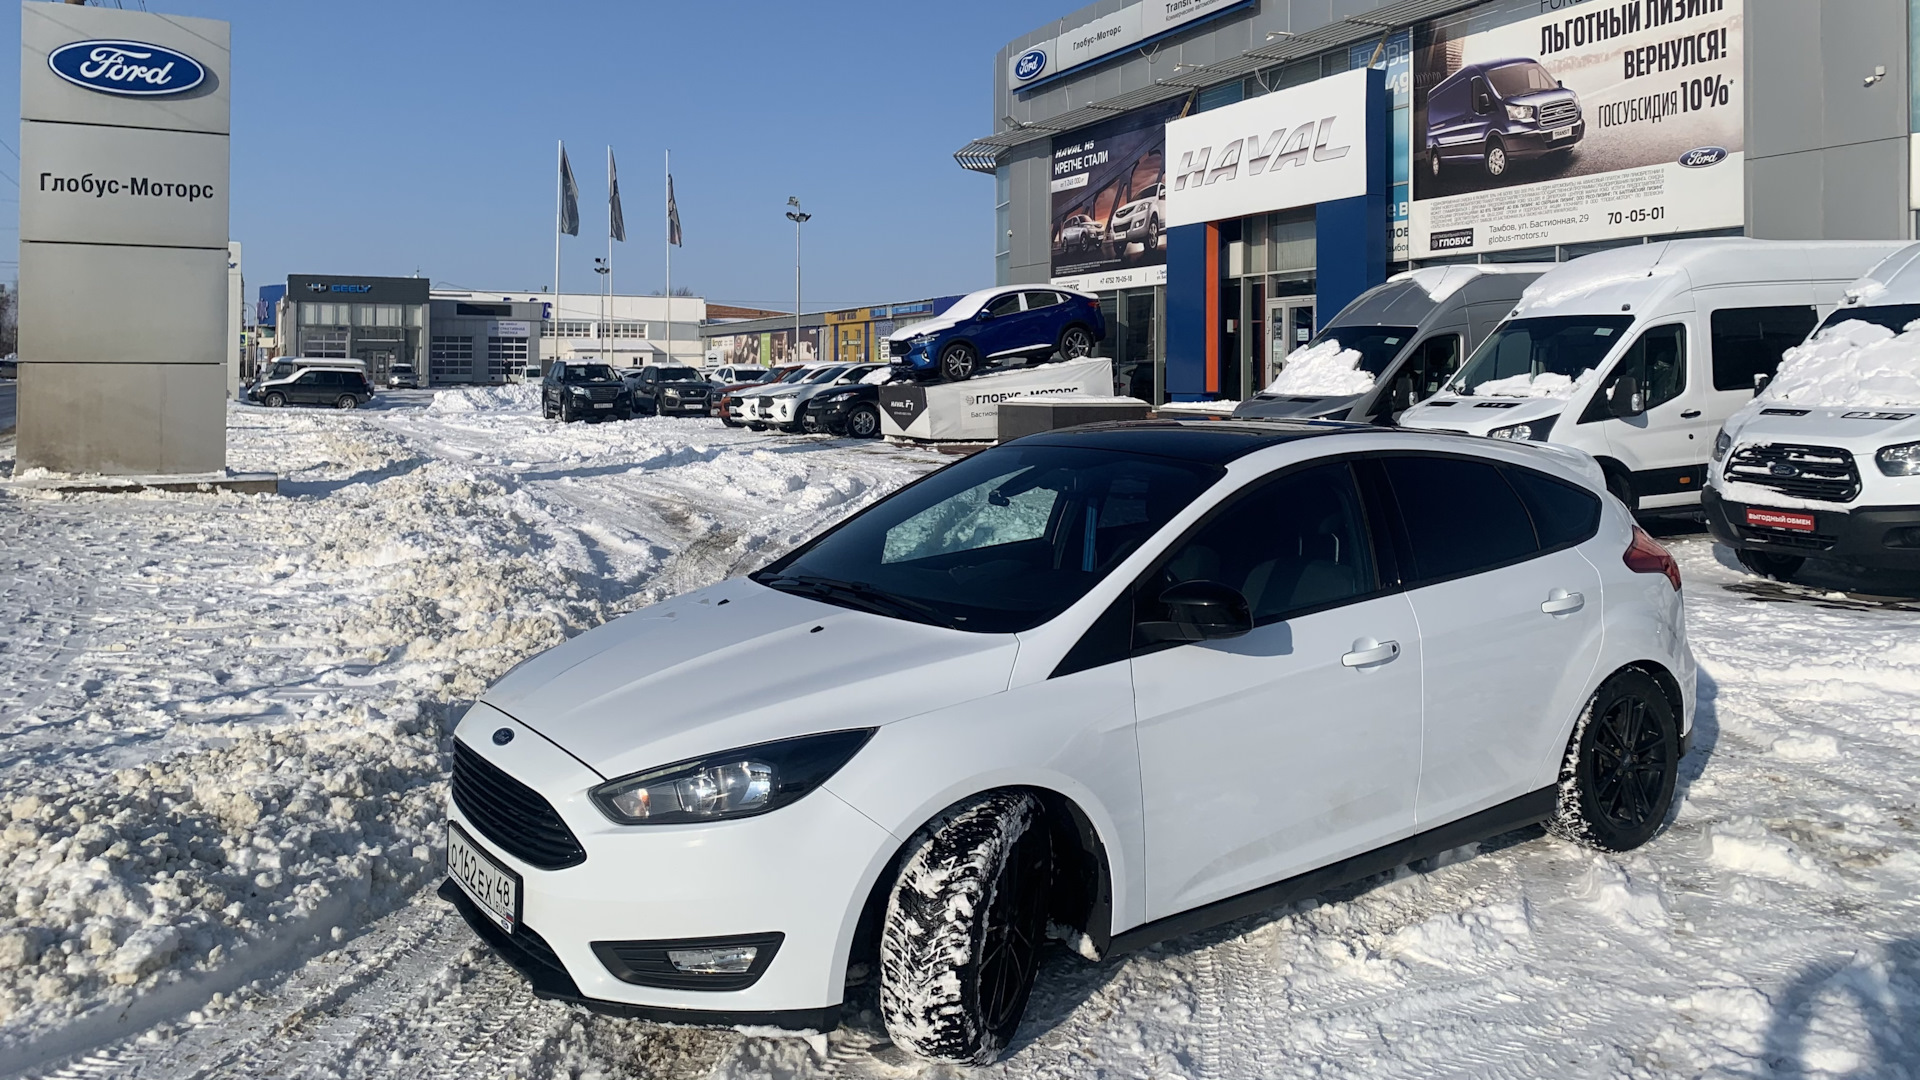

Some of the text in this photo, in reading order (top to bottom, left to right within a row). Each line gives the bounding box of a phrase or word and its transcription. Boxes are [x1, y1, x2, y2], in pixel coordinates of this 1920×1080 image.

[1073, 25, 1122, 51] Глобус-Моторс
[1540, 0, 1641, 56] ЛЬГОТНЫЙ
[1018, 52, 1039, 74] Ford
[1624, 27, 1727, 80] ВЕРНУЛСЯ!
[80, 47, 175, 85] Ford
[1598, 90, 1678, 128] ГОССУБСИДИЯ
[1554, 128, 1570, 138] TRANSIT
[1055, 143, 1083, 159] HAVAL
[1173, 115, 1352, 192] HAVAL
[1687, 149, 1719, 166] Ford
[1054, 150, 1109, 175] КРЕПЧЕ СТАЛИ
[40, 172, 215, 202] Глобус-Моторс
[1489, 213, 1590, 233] Тамбов, ул. Бастионная, 29
[1438, 235, 1472, 247] ГЛОБУС
[1488, 231, 1549, 245] globus-motors.ru
[331, 284, 372, 293] GEELY
[1748, 512, 1811, 526] ВЫГОДНЫЙ ОБМЕН
[496, 876, 510, 907] 48
[496, 901, 506, 916] RUS
